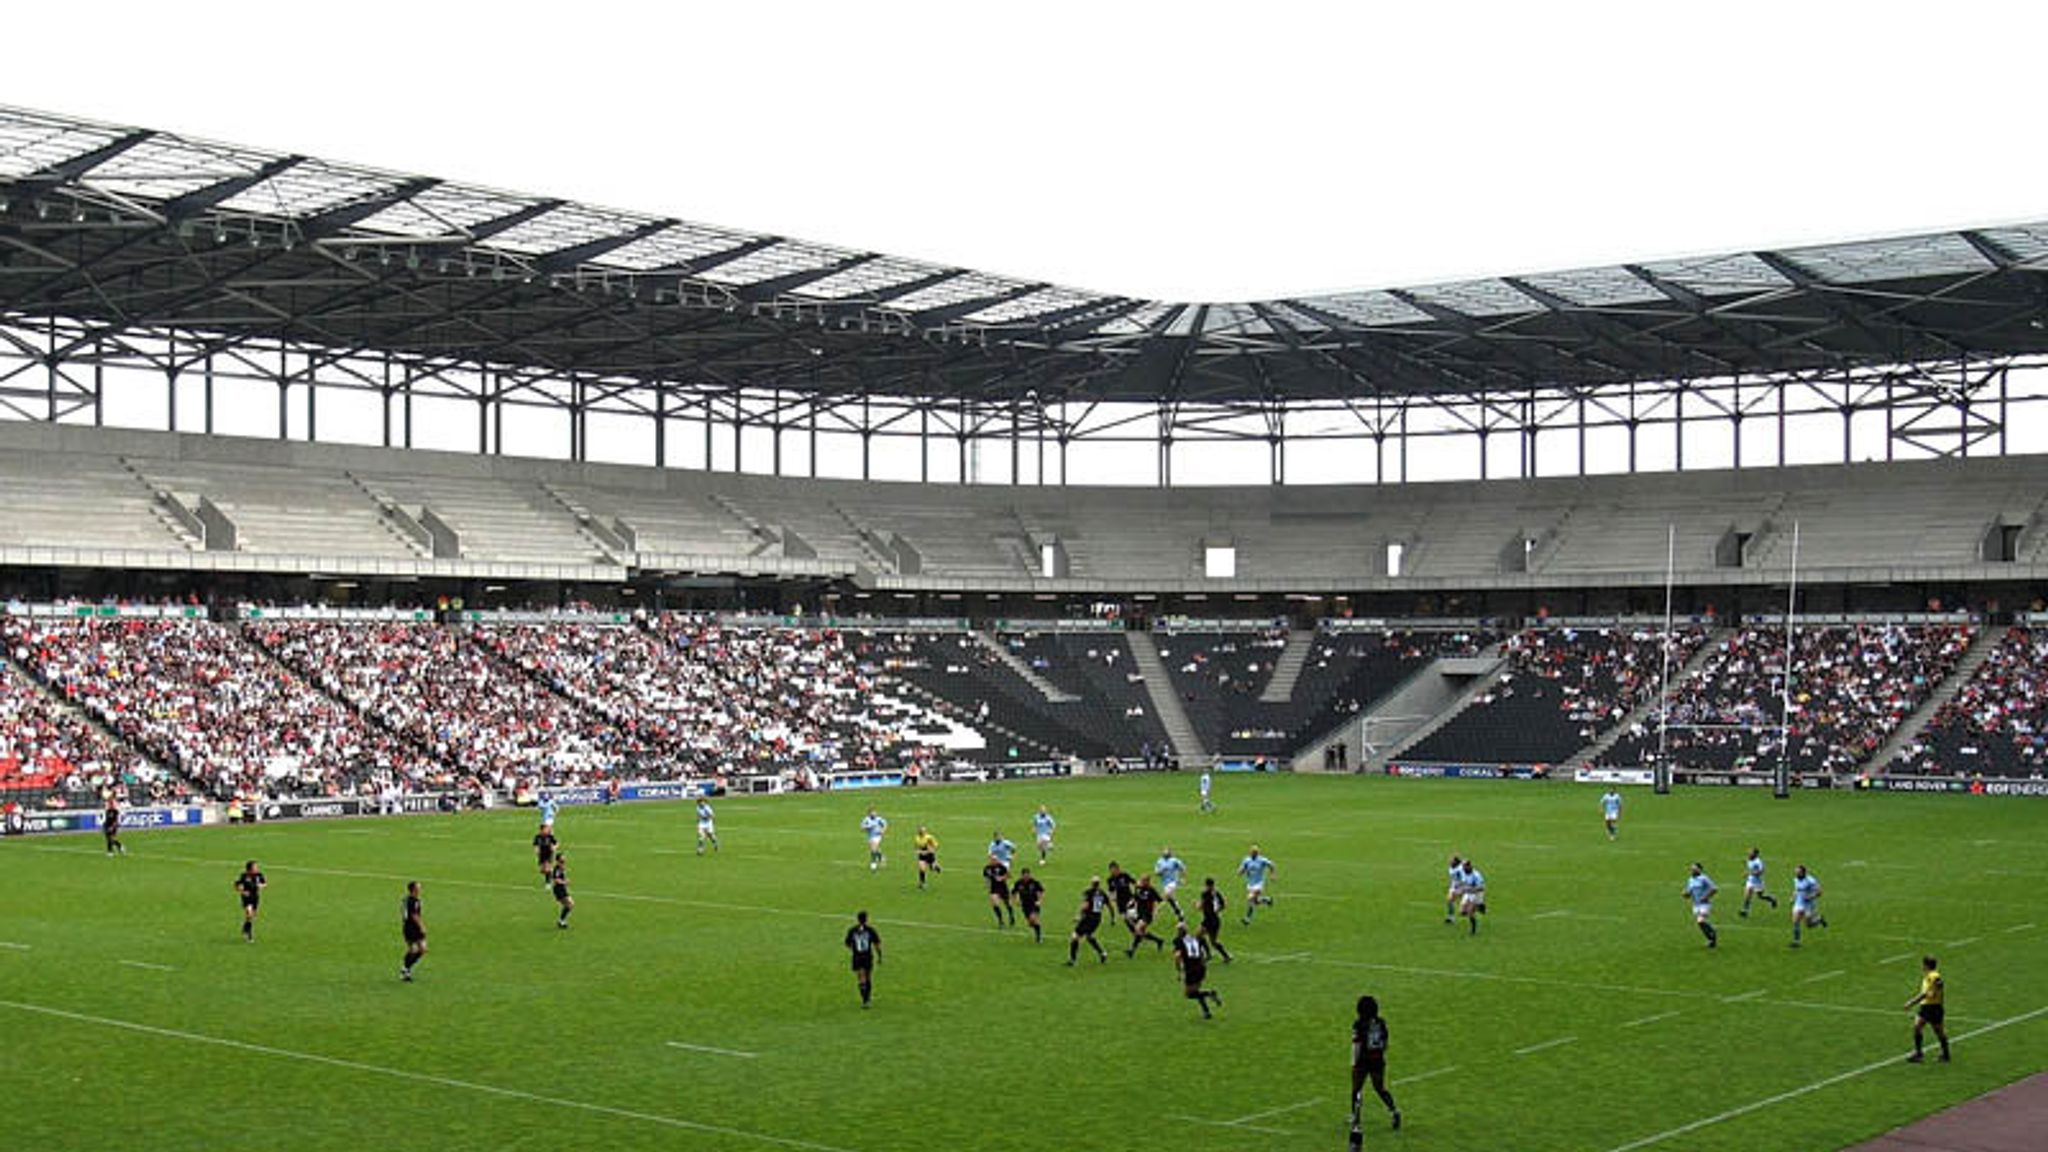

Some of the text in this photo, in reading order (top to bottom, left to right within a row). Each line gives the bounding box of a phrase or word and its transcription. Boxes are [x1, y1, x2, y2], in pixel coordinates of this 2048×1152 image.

[1888, 780, 1947, 791] LAND ROVER
[300, 803, 344, 818] GUINNESS
